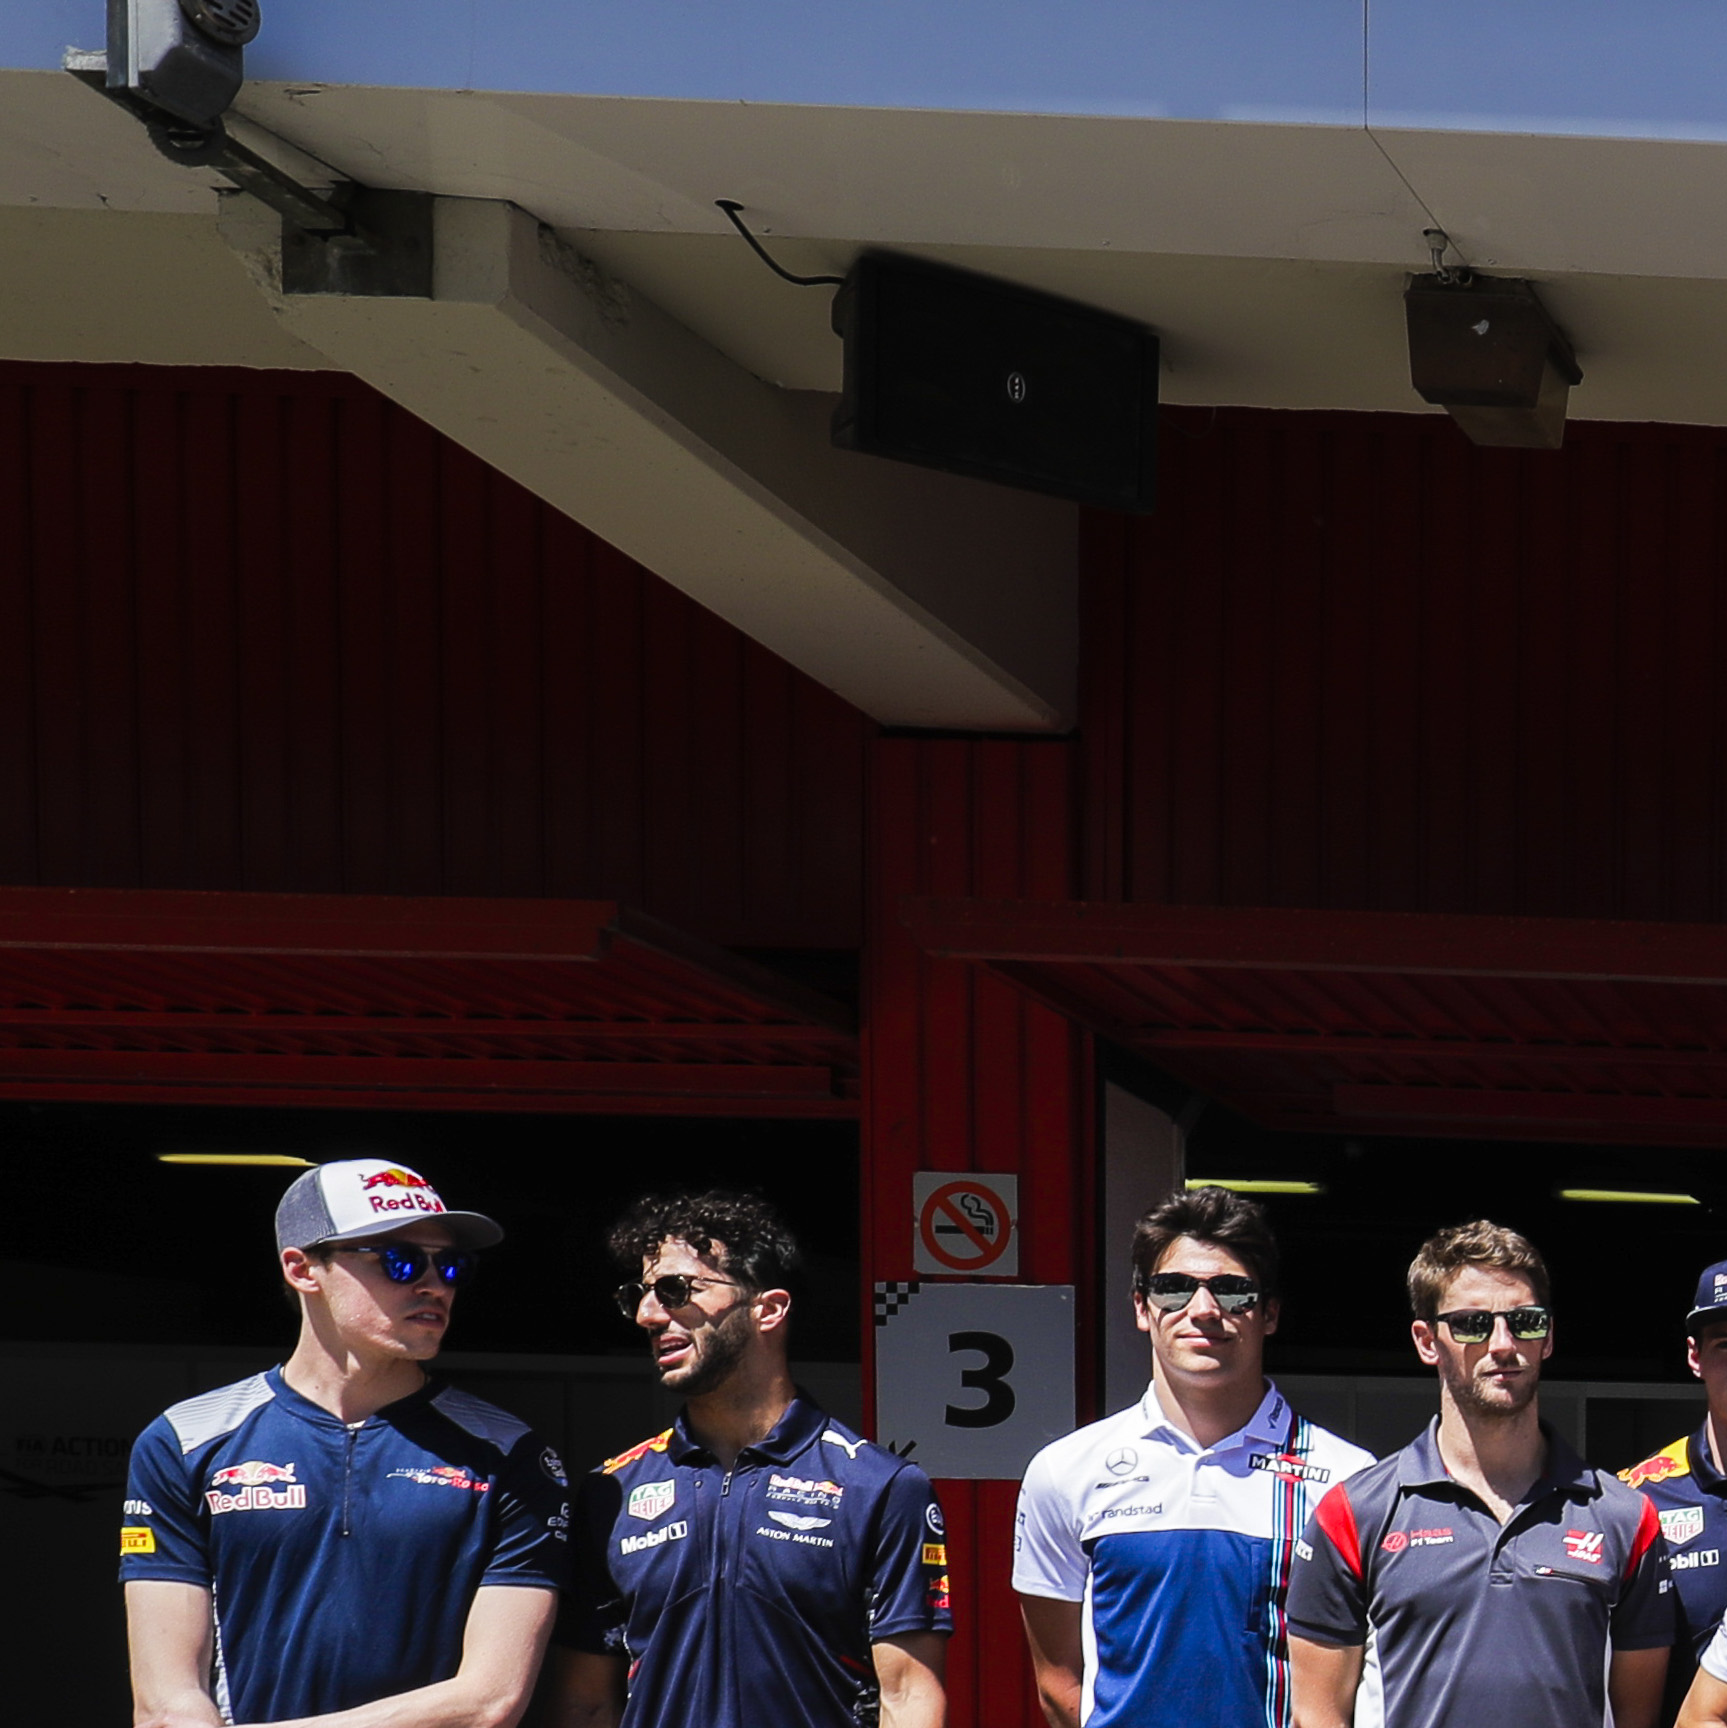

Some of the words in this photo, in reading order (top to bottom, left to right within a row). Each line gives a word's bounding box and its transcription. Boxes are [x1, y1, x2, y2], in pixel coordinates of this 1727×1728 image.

[369, 1193, 415, 1213] Red
[944, 1331, 1016, 1428] 3
[1251, 1454, 1329, 1483] MARTINI
[207, 1488, 250, 1513] Red
[254, 1486, 304, 1508] Bull
[637, 1481, 674, 1500] TAG
[631, 1496, 673, 1518] HEUER
[1101, 1503, 1162, 1518] randstad
[1662, 1509, 1700, 1524] TAG
[621, 1528, 667, 1555] Mobil
[668, 1520, 687, 1540] 1
[756, 1527, 790, 1541] ASTON
[792, 1533, 834, 1548] MARTIN
[1663, 1521, 1702, 1541] HEUER
[1670, 1552, 1698, 1570] obil
[1700, 1550, 1719, 1566] 1
